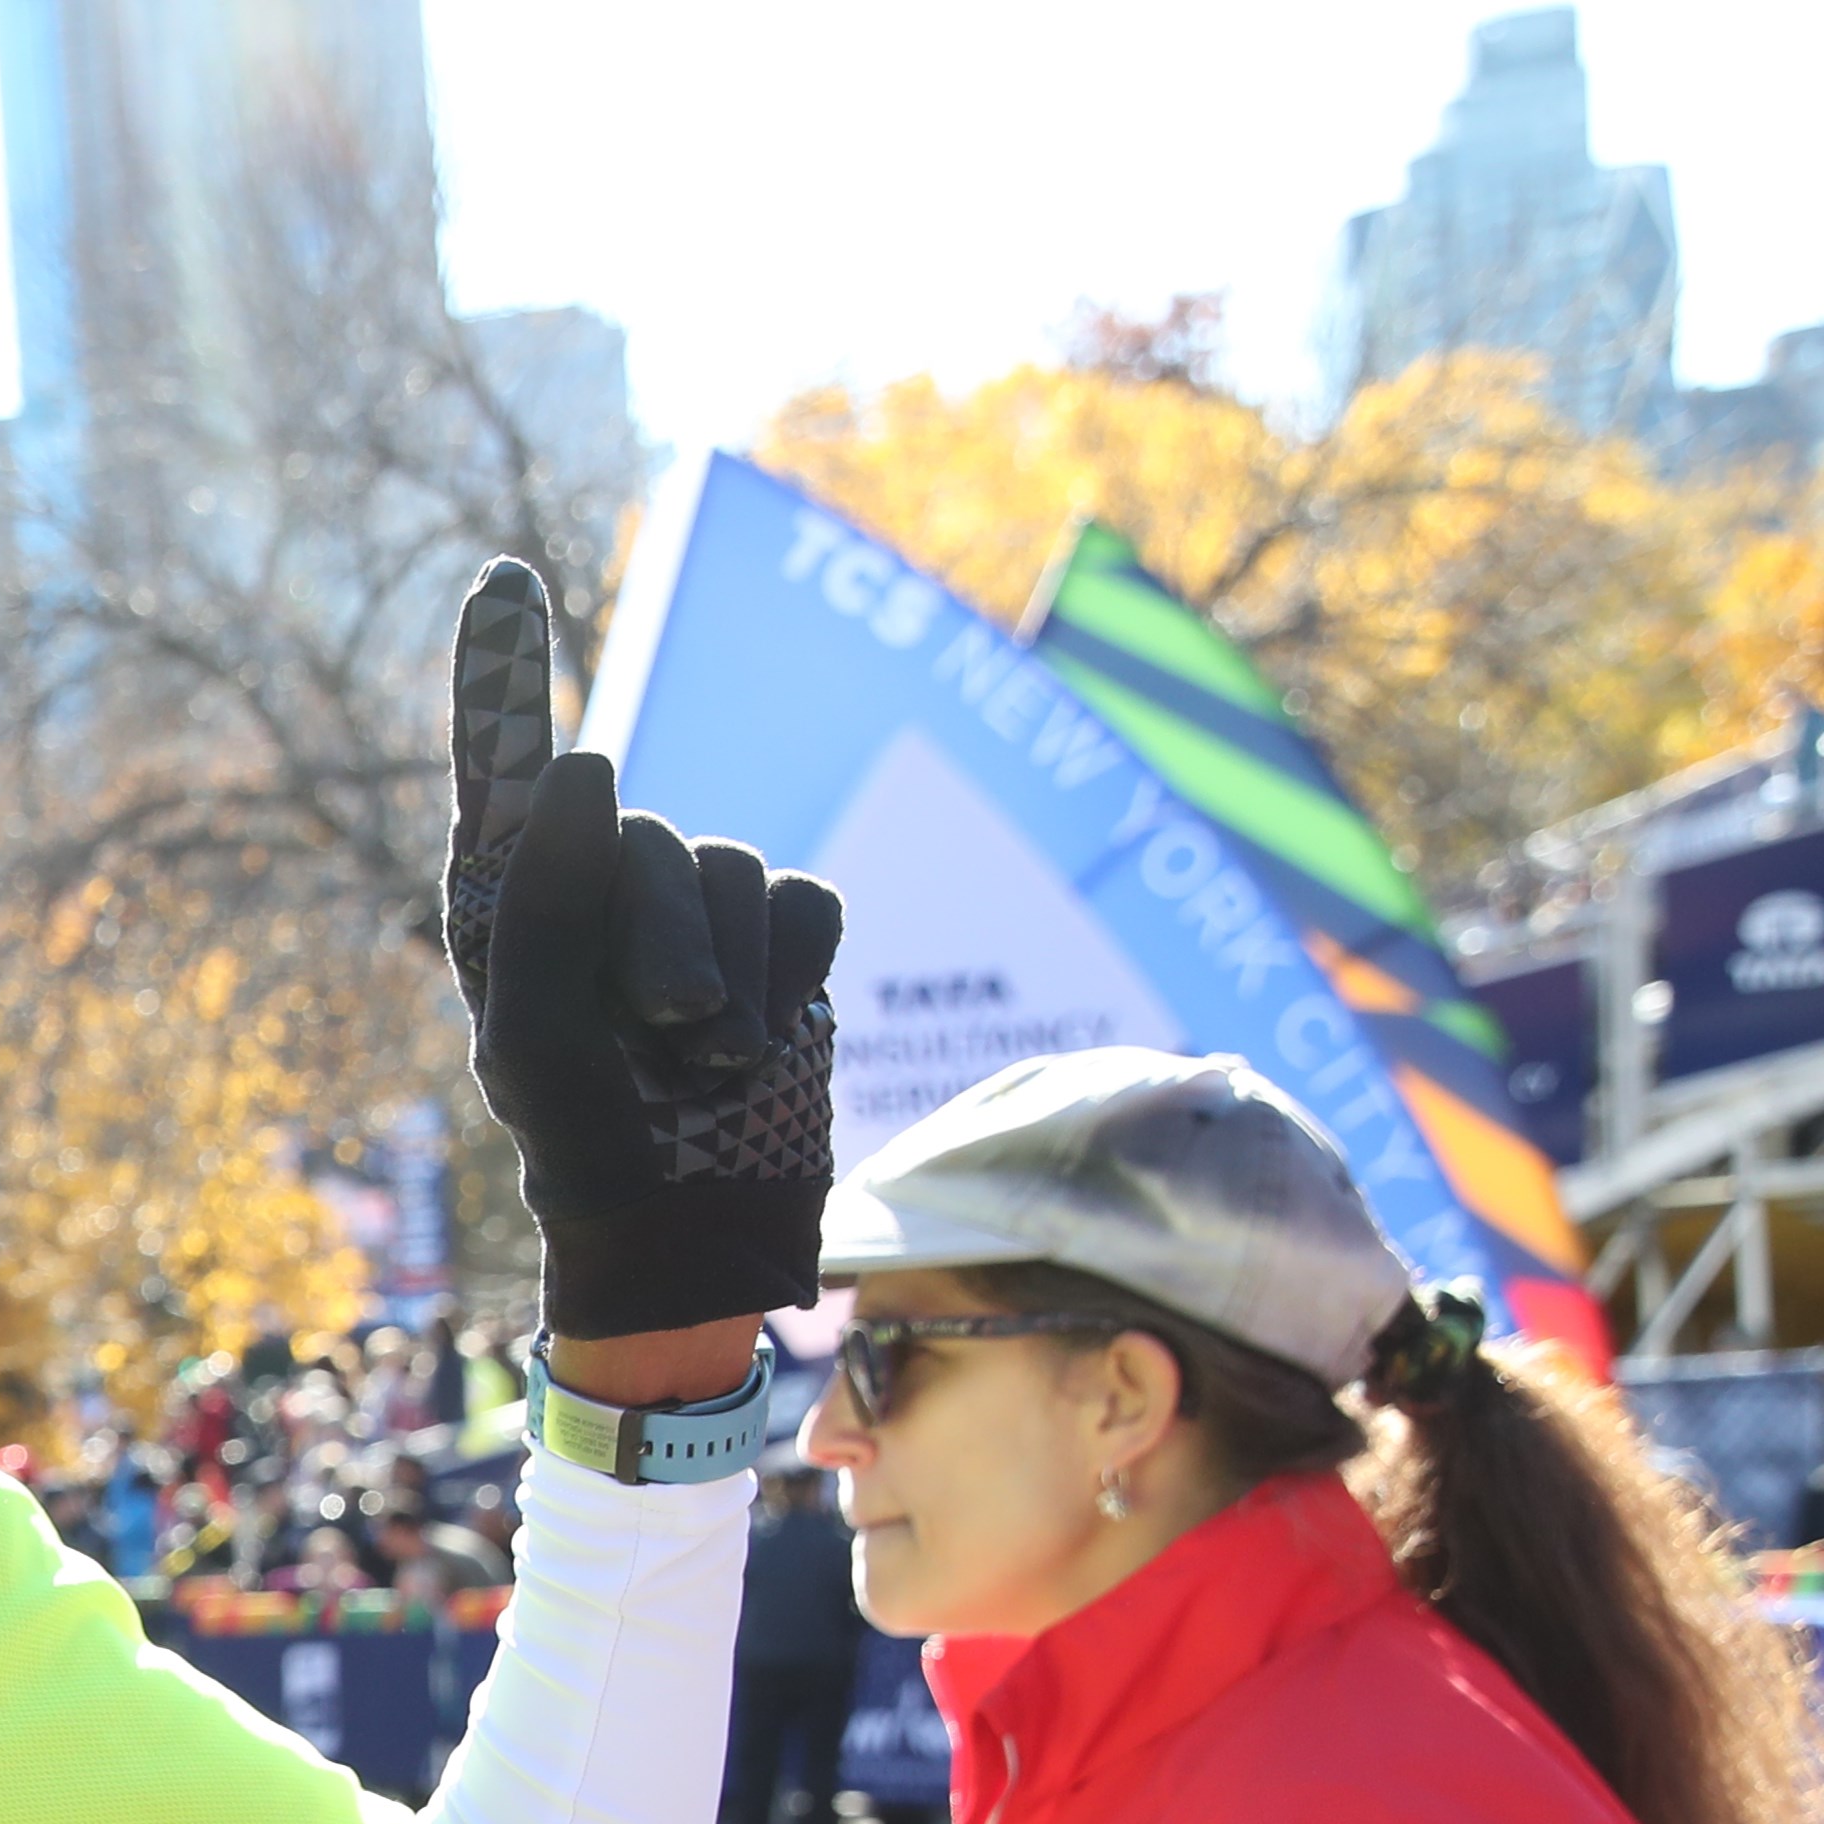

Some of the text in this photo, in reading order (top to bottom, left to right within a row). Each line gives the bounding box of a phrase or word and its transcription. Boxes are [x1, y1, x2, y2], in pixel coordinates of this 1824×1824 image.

[779, 508, 1430, 1192] TCS NEW YORK CITY
[874, 970, 1014, 1012] TATA
